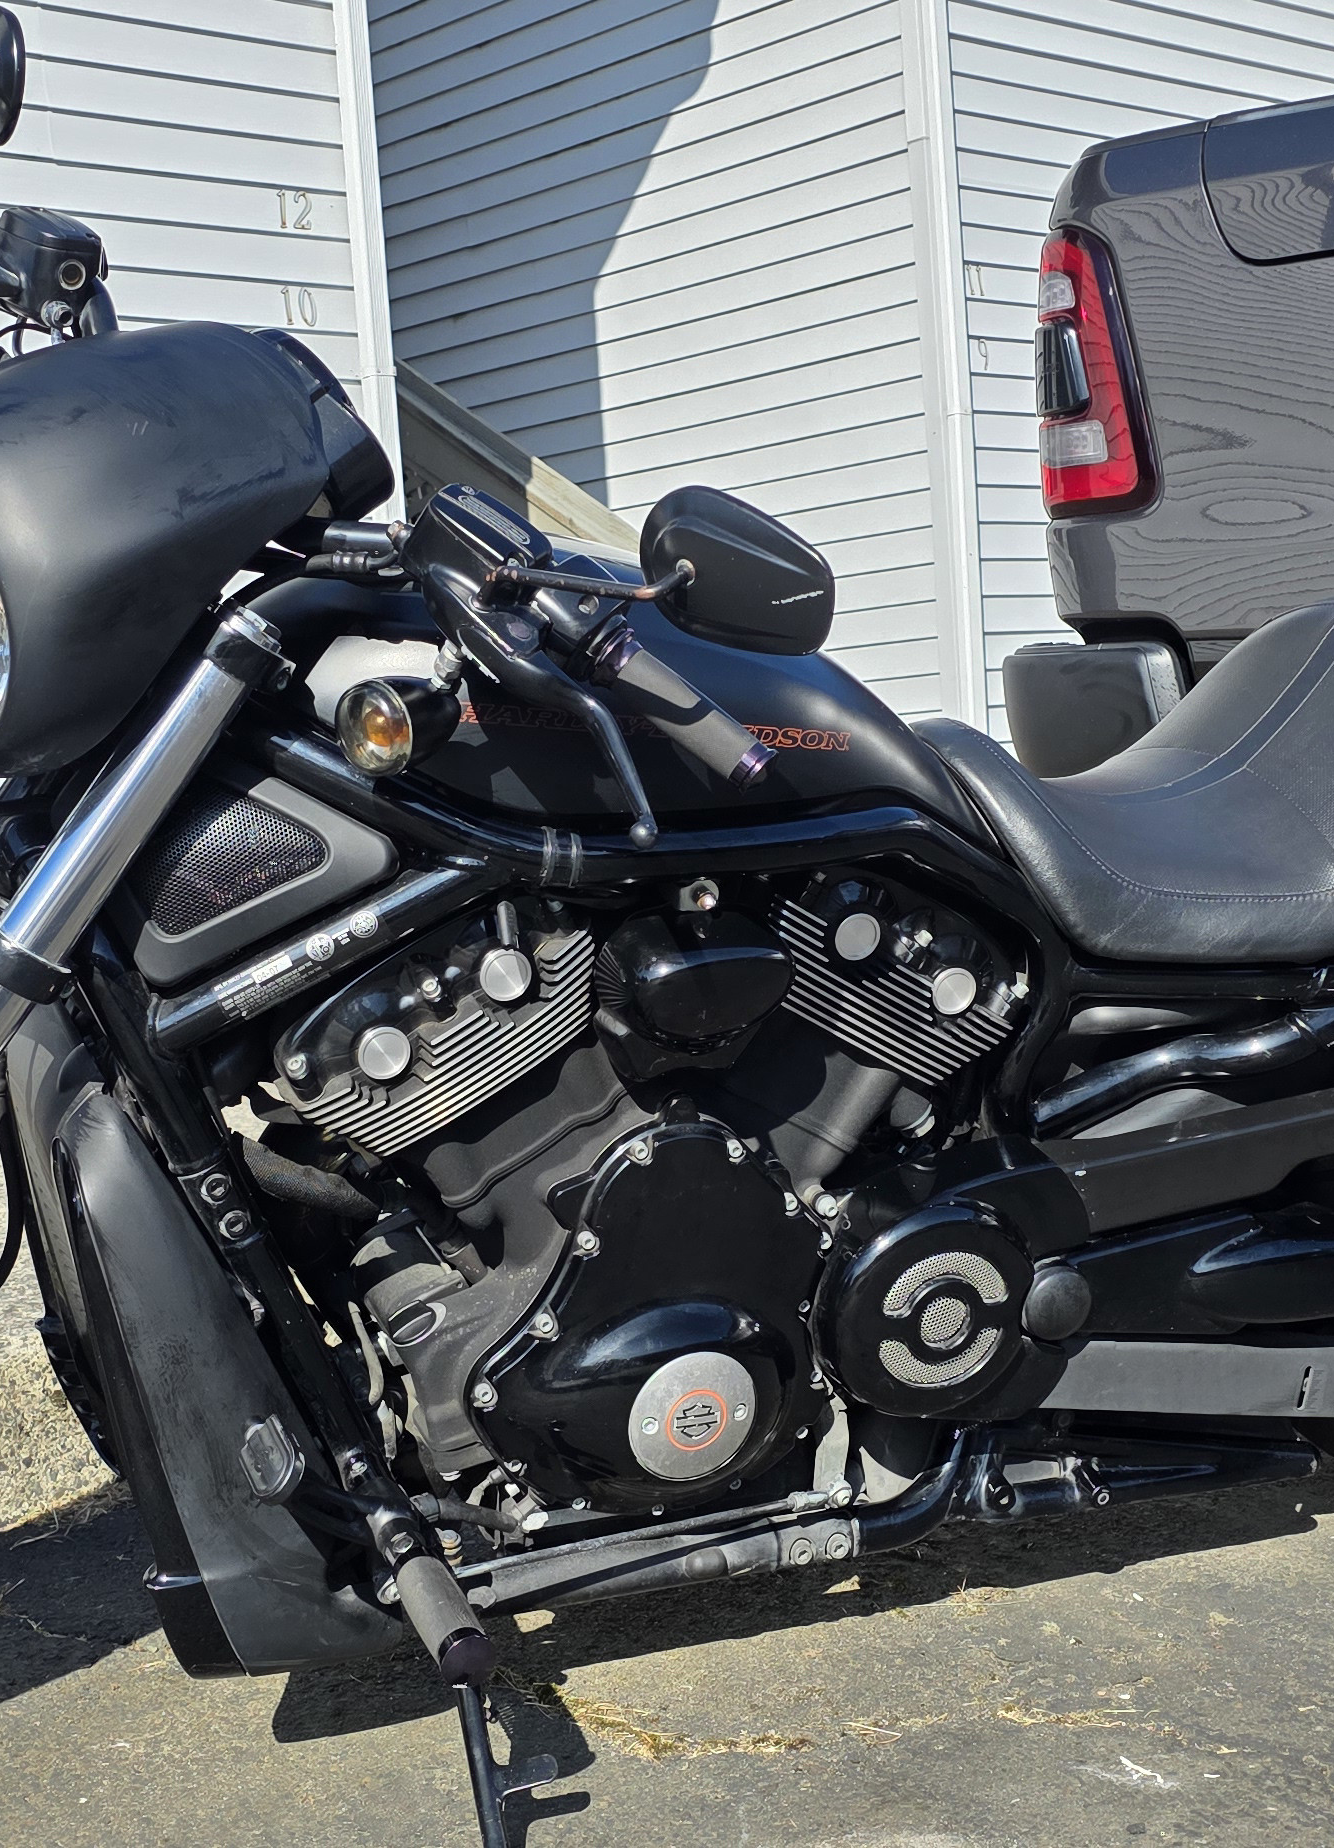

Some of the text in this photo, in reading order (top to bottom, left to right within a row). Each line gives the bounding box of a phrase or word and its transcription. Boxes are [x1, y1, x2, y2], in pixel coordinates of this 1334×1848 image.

[276, 189, 312, 230] 12
[966, 264, 985, 296] 11
[280, 285, 317, 327] 10
[978, 338, 989, 371] 9
